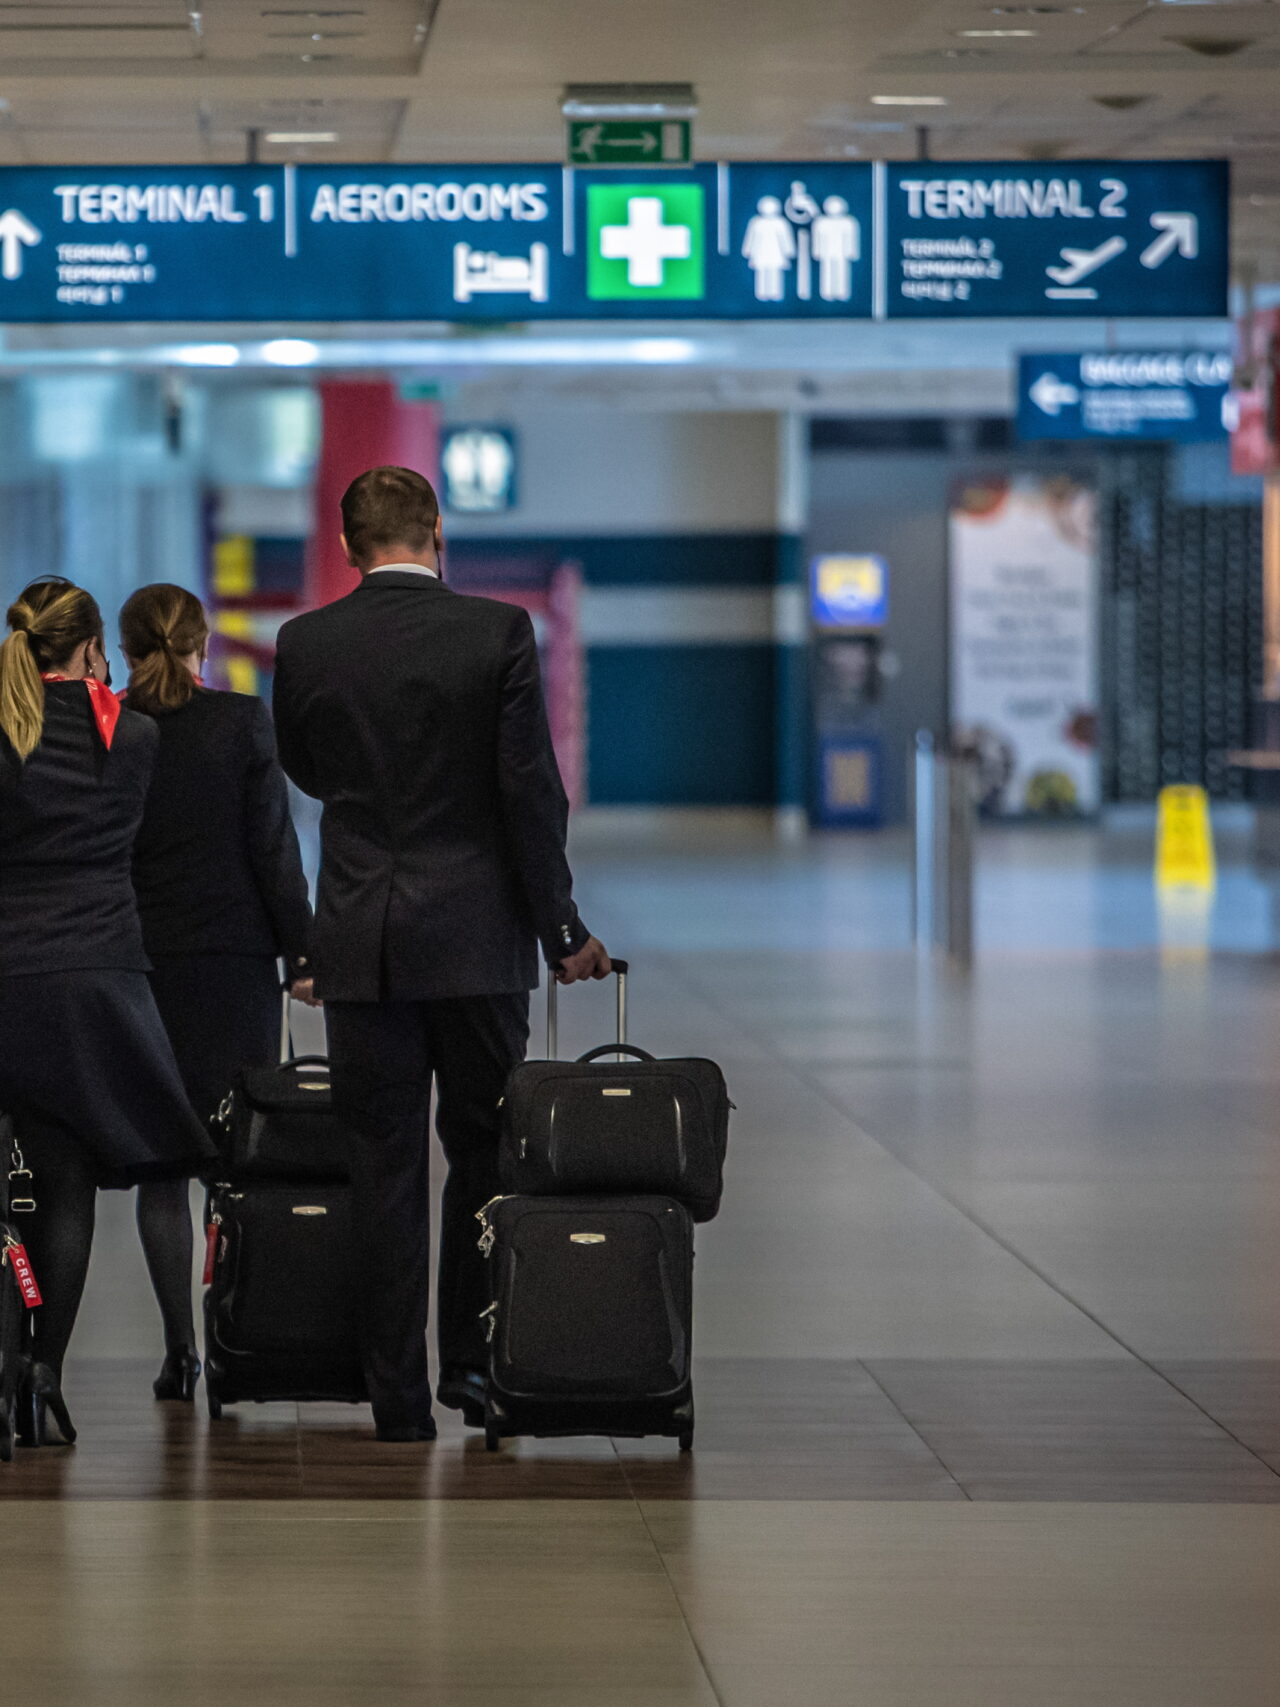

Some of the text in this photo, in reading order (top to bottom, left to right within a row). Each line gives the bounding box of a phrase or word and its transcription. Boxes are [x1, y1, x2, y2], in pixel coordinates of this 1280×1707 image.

[53, 184, 274, 223] TERMINAL 1
[310, 183, 548, 222] AEROROOMS
[899, 178, 1127, 219] TERMINAL 2
[15, 1258, 37, 1298] CREW
